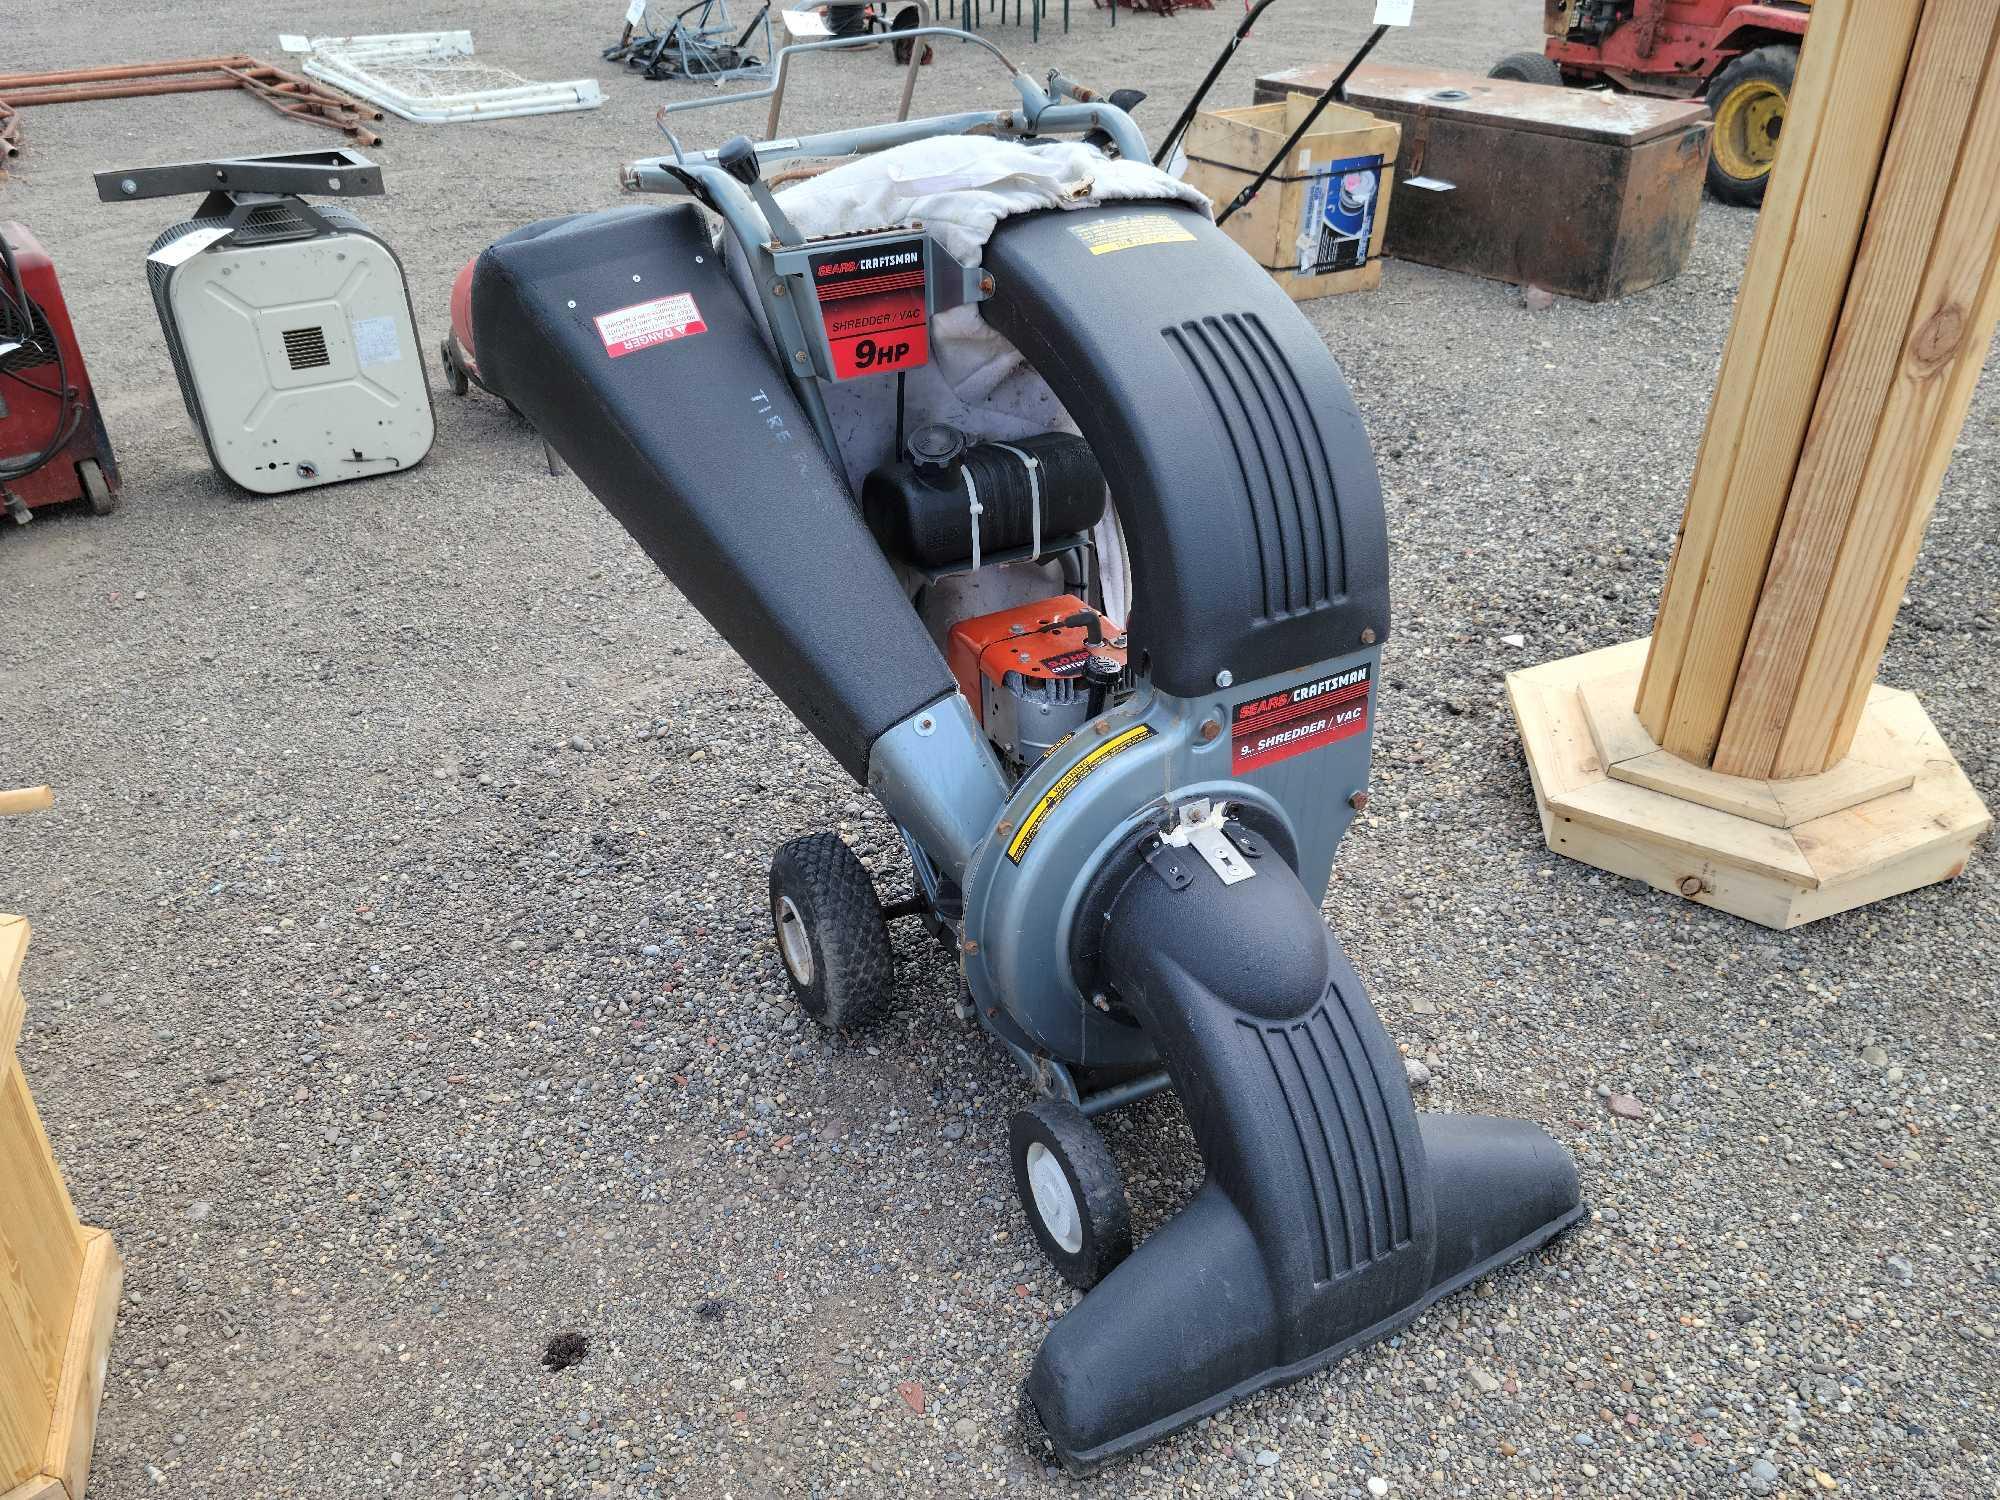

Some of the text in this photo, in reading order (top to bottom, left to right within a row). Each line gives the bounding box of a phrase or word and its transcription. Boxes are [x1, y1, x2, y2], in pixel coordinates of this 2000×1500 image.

[832, 314, 890, 332] SHREDDER
[899, 309, 921, 320] VAC
[623, 328, 674, 350] DANGER
[1052, 660, 1087, 673] CRAFTSM
[1257, 720, 1327, 750] SHREDDER
[1336, 707, 1362, 724] VAC
[1053, 759, 1090, 793] WARNING
